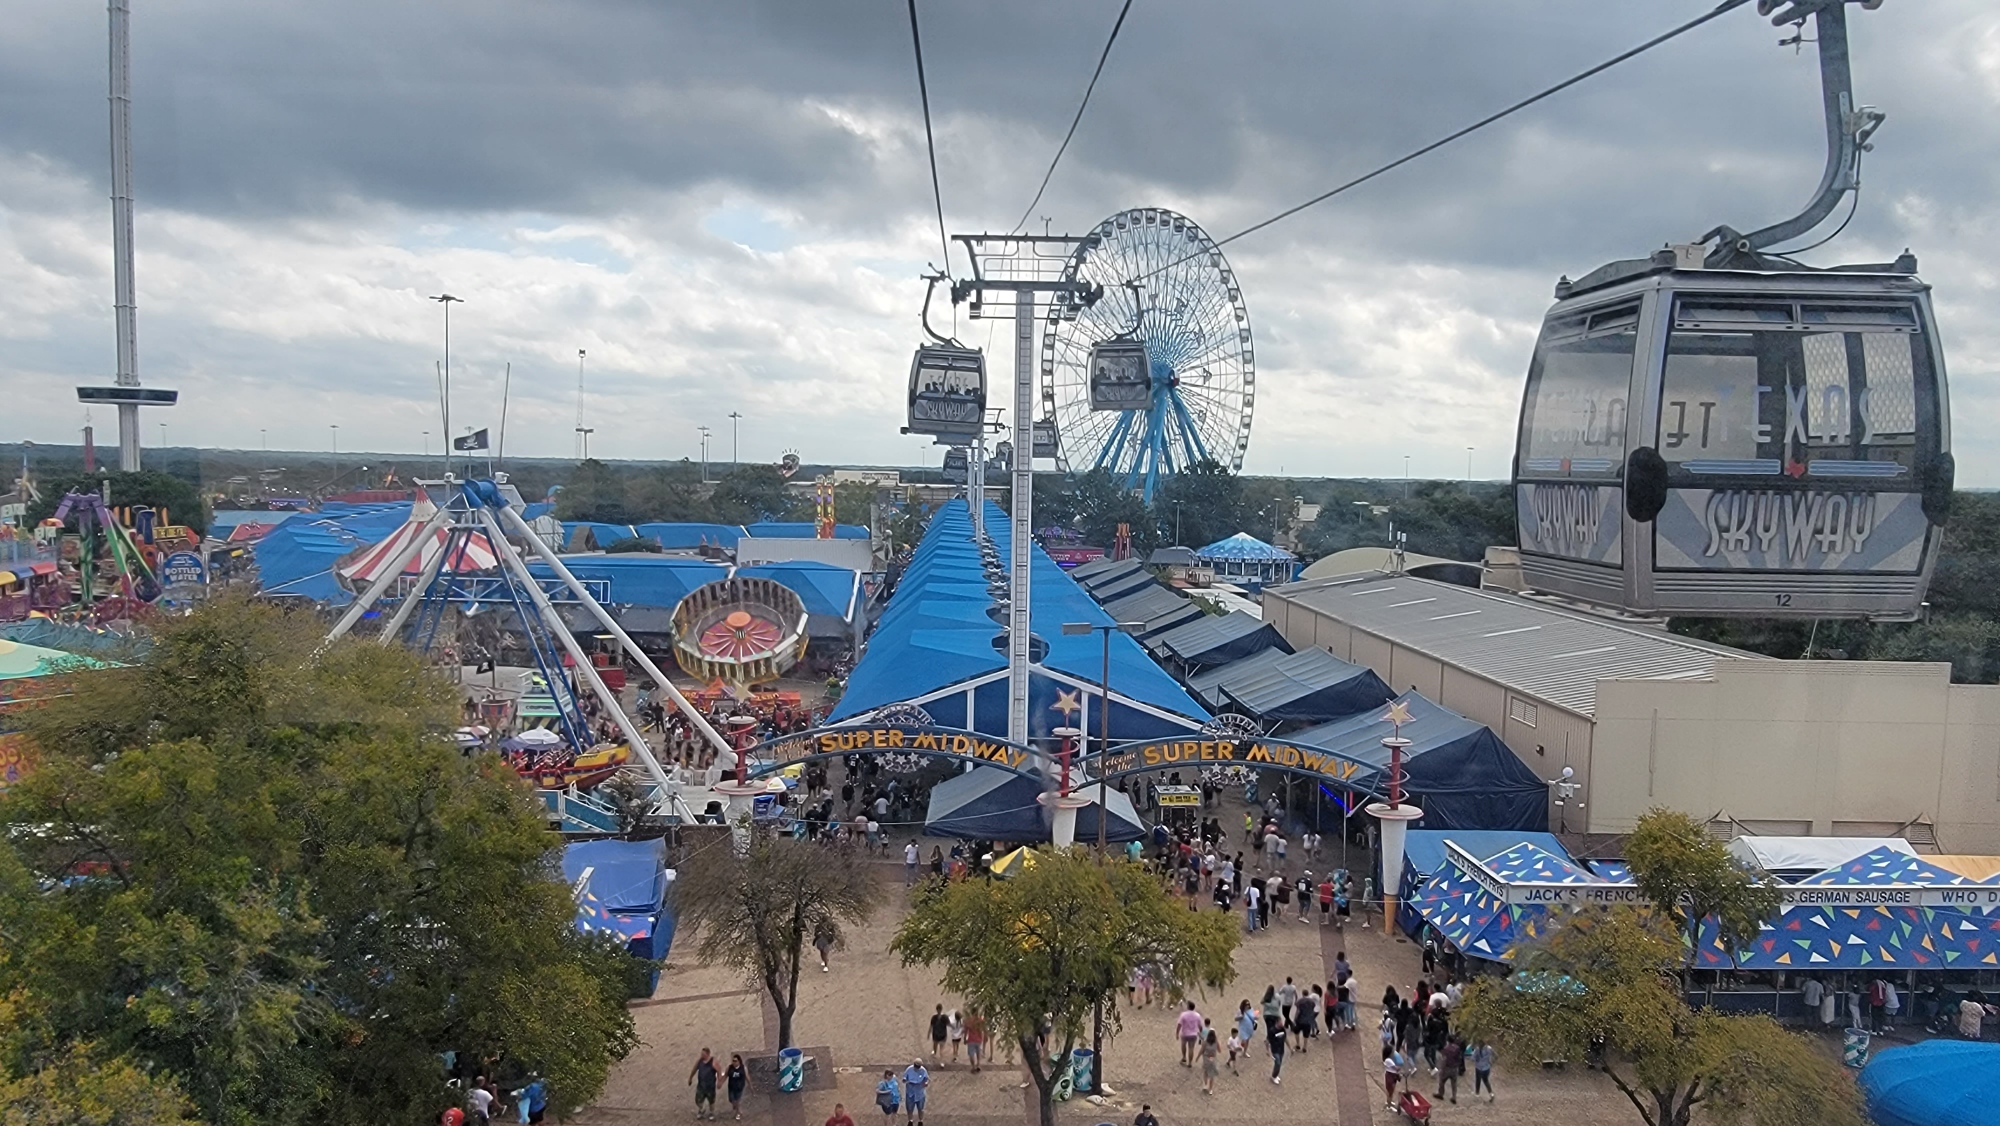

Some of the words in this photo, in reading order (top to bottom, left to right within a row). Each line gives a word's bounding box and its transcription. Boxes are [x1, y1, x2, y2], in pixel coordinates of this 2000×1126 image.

[1715, 384, 1874, 445] TEXAS
[1535, 486, 1599, 543] SKYWAY
[1705, 492, 1876, 560] SKYWAY
[1774, 594, 1792, 607] 12
[821, 729, 904, 752] SUPER
[913, 731, 1028, 768] MIDWAY
[1144, 740, 1234, 765] SUPER
[1246, 743, 1359, 780] MIDWAY
[1118, 762, 1132, 771] the
[1525, 889, 1578, 901] JACK'S
[1799, 891, 1851, 903] GERMAN
[1855, 891, 1911, 903] SAUSAGE
[1941, 891, 1978, 903] WHO
[1988, 891, 2000, 903] D
